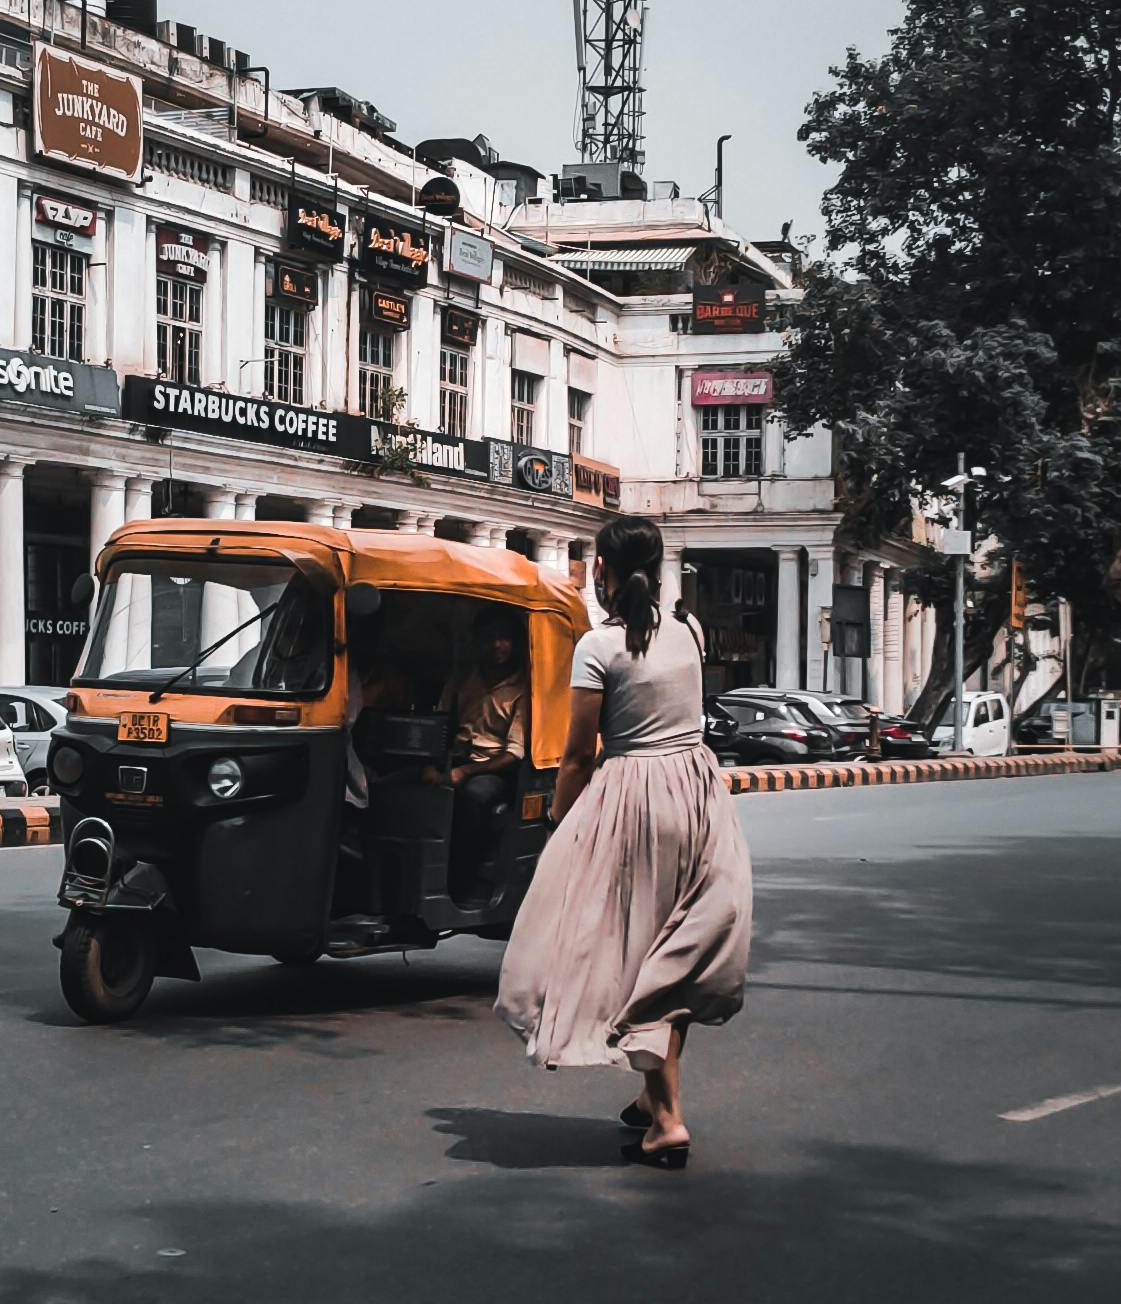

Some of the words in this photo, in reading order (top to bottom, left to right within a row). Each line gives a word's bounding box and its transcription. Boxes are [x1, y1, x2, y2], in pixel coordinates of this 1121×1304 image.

[82, 80, 100, 97] THE
[55, 93, 127, 137] JUNKYARD
[80, 122, 102, 141] CAFE
[41, 200, 94, 228] FLYP
[153, 384, 270, 429] STARBUCKS
[274, 409, 337, 442] COFFEE
